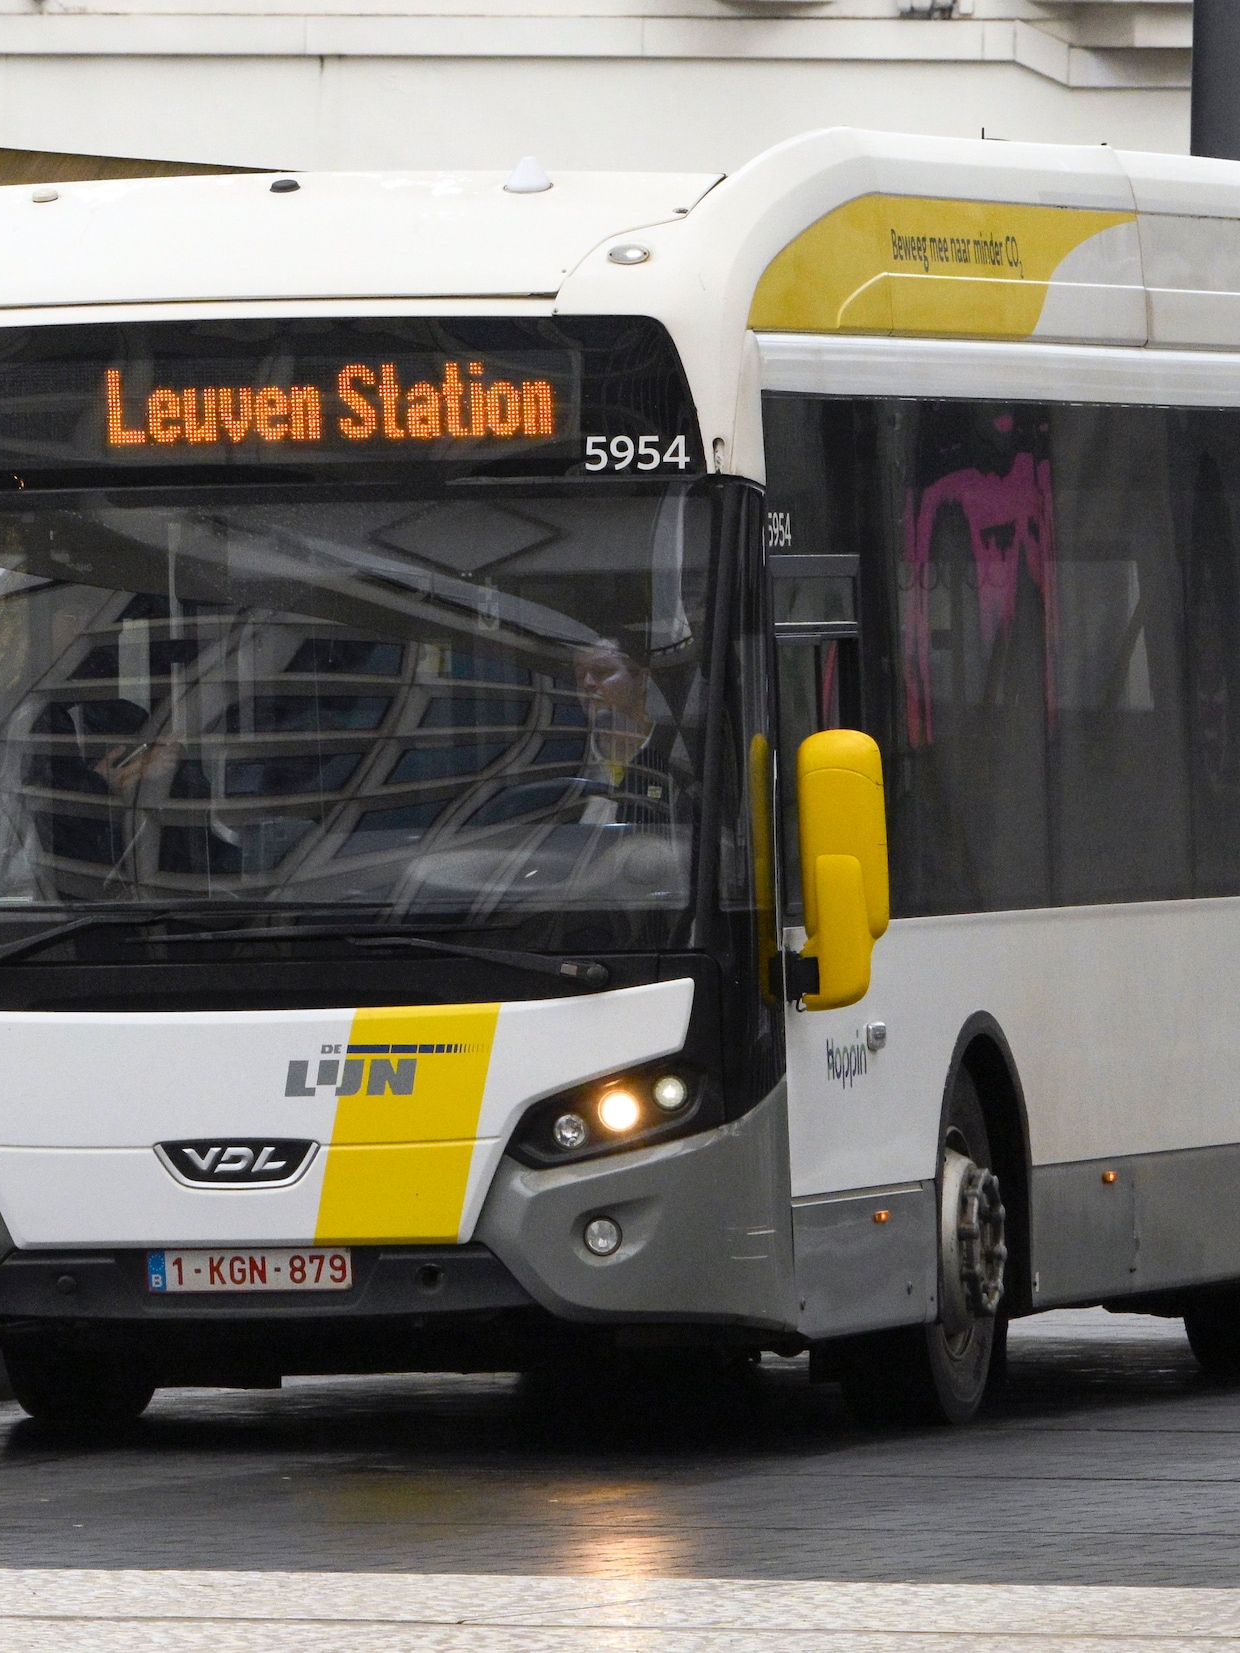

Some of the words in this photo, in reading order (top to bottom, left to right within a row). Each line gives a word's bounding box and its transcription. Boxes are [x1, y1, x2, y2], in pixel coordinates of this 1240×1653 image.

[890, 228, 929, 273] Beweeg
[929, 236, 949, 263] mee
[950, 237, 971, 264] naar
[973, 231, 1004, 267] minder
[106, 368, 322, 445] Leuven
[337, 361, 555, 440] Station
[585, 434, 691, 471] 5954
[320, 1044, 342, 1054] DE
[826, 1028, 867, 1090] Hoppin
[181, 1146, 287, 1174] VDL
[151, 1273, 163, 1288] B
[171, 1253, 348, 1286] 1-KGN-879
